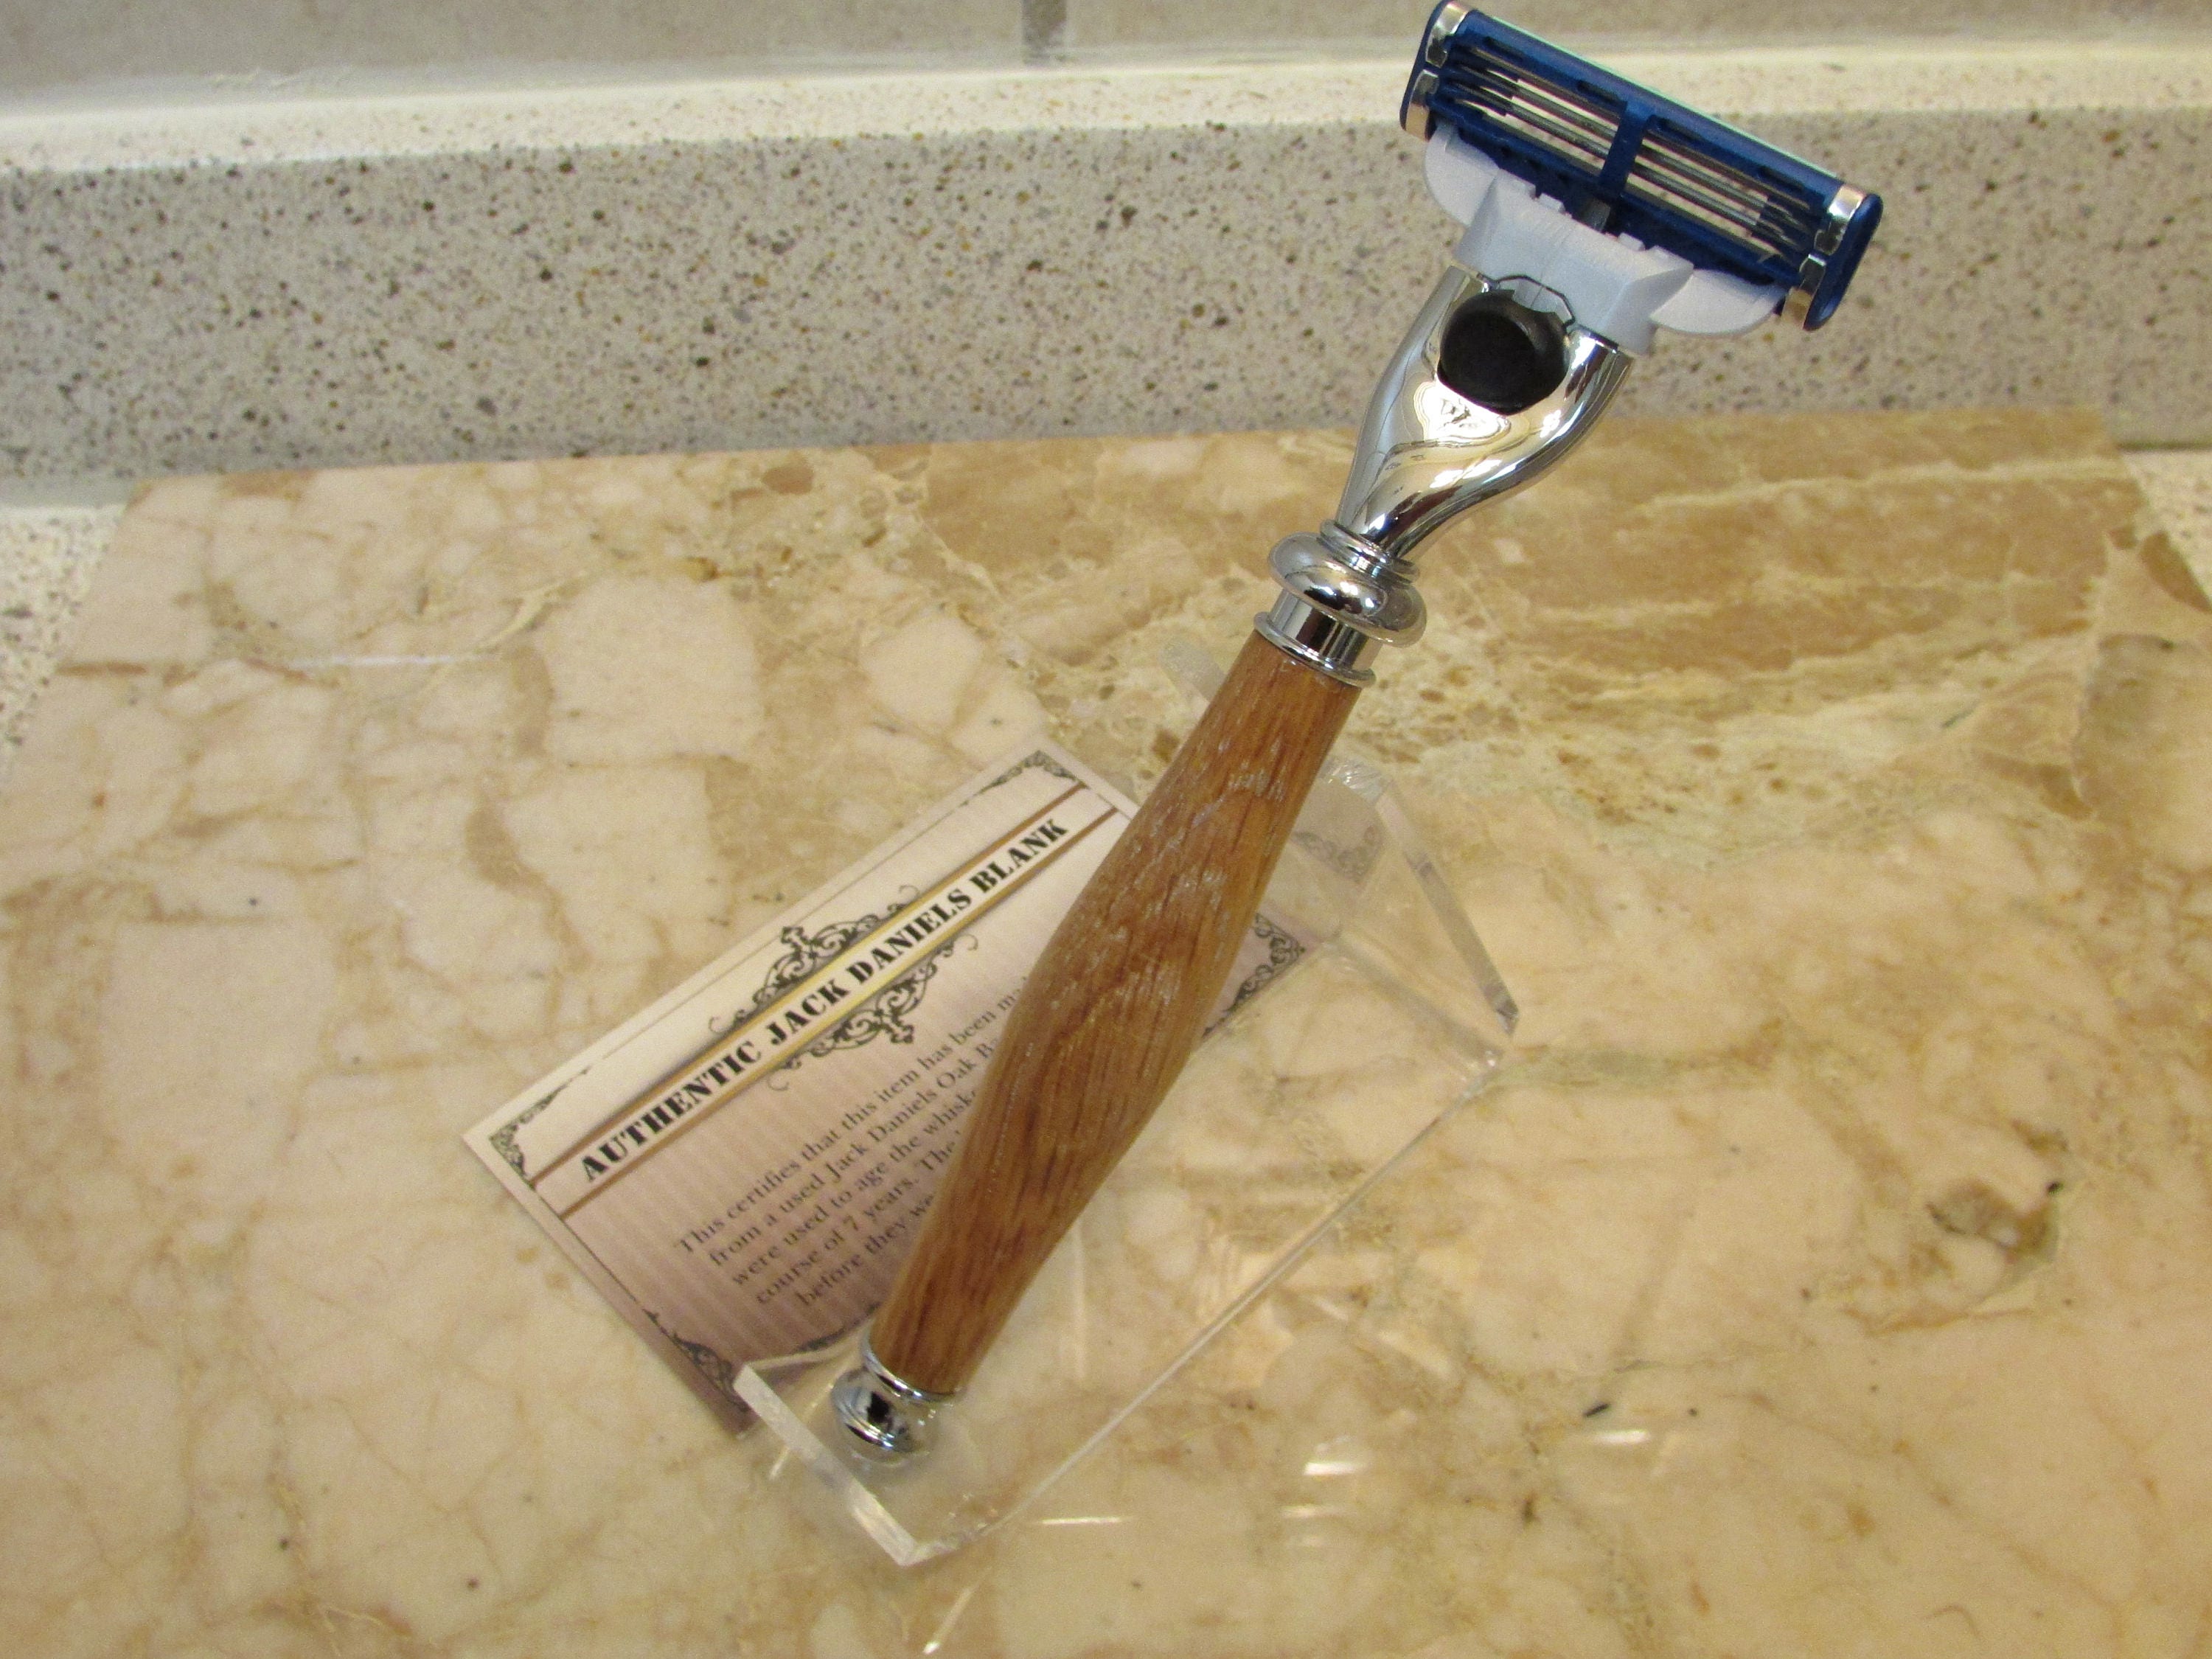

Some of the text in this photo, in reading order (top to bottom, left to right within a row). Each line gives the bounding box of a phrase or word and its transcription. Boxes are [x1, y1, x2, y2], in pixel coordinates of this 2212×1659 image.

[581, 818, 1069, 1180] AUTHENTIC JACK DANIELS BLANK
[673, 1009, 996, 1253] This certifies that this item has been
[709, 1225, 762, 1266] from
[765, 1212, 779, 1227] a
[779, 1173, 827, 1214] used
[825, 1144, 869, 1183] Jack
[867, 1088, 937, 1143] Daniels
[936, 1057, 978, 1089] Oak
[732, 1246, 781, 1284] were
[783, 1203, 830, 1245] used
[830, 1190, 853, 1209] to
[855, 1161, 887, 1192] age
[889, 1135, 921, 1163] the
[756, 1251, 823, 1304] course
[824, 1229, 846, 1251] of
[843, 1214, 859, 1231] 7
[794, 1253, 864, 1306] before
[864, 1217, 907, 1255] they
